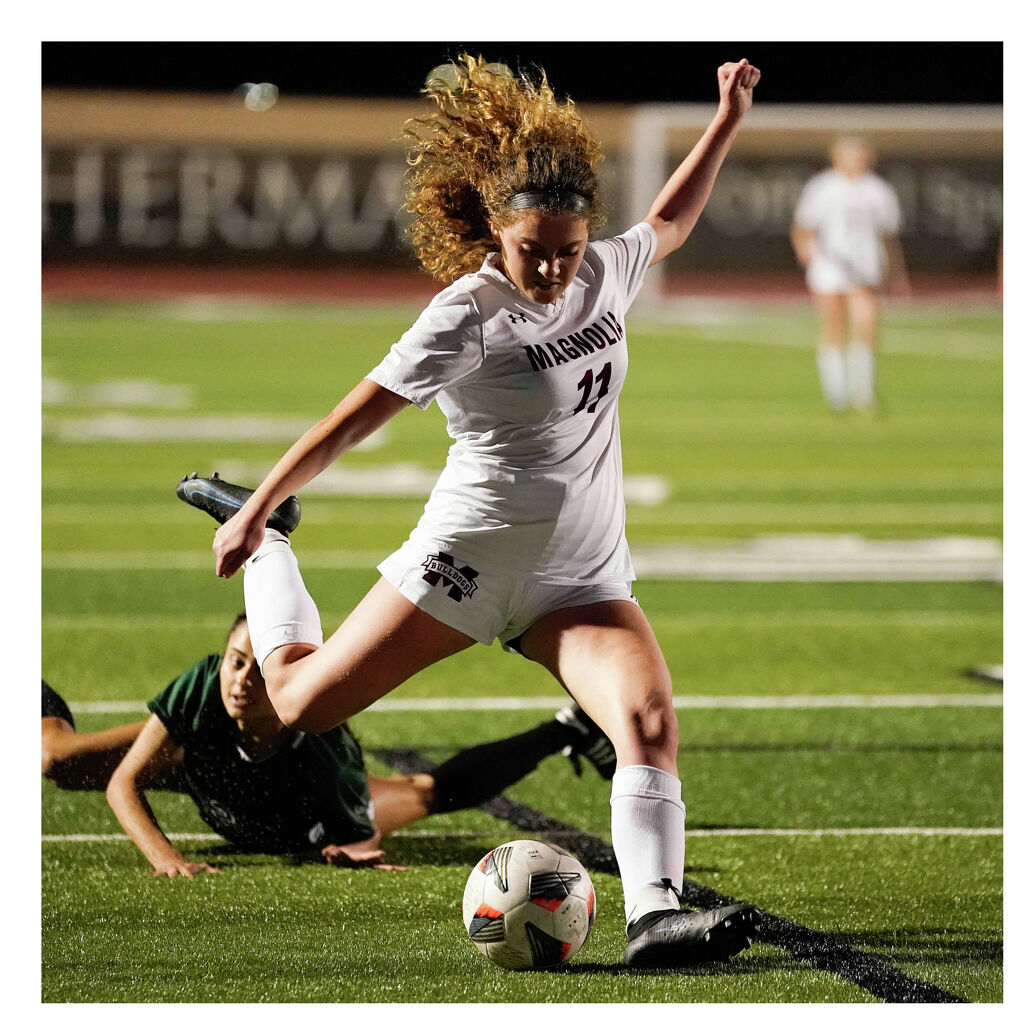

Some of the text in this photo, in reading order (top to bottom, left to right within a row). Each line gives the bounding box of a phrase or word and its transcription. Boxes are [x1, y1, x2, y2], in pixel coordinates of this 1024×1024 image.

[523, 311, 624, 371] MAGNOLIA
[573, 361, 612, 416] 11
[430, 562, 470, 590] BULLDOGS
